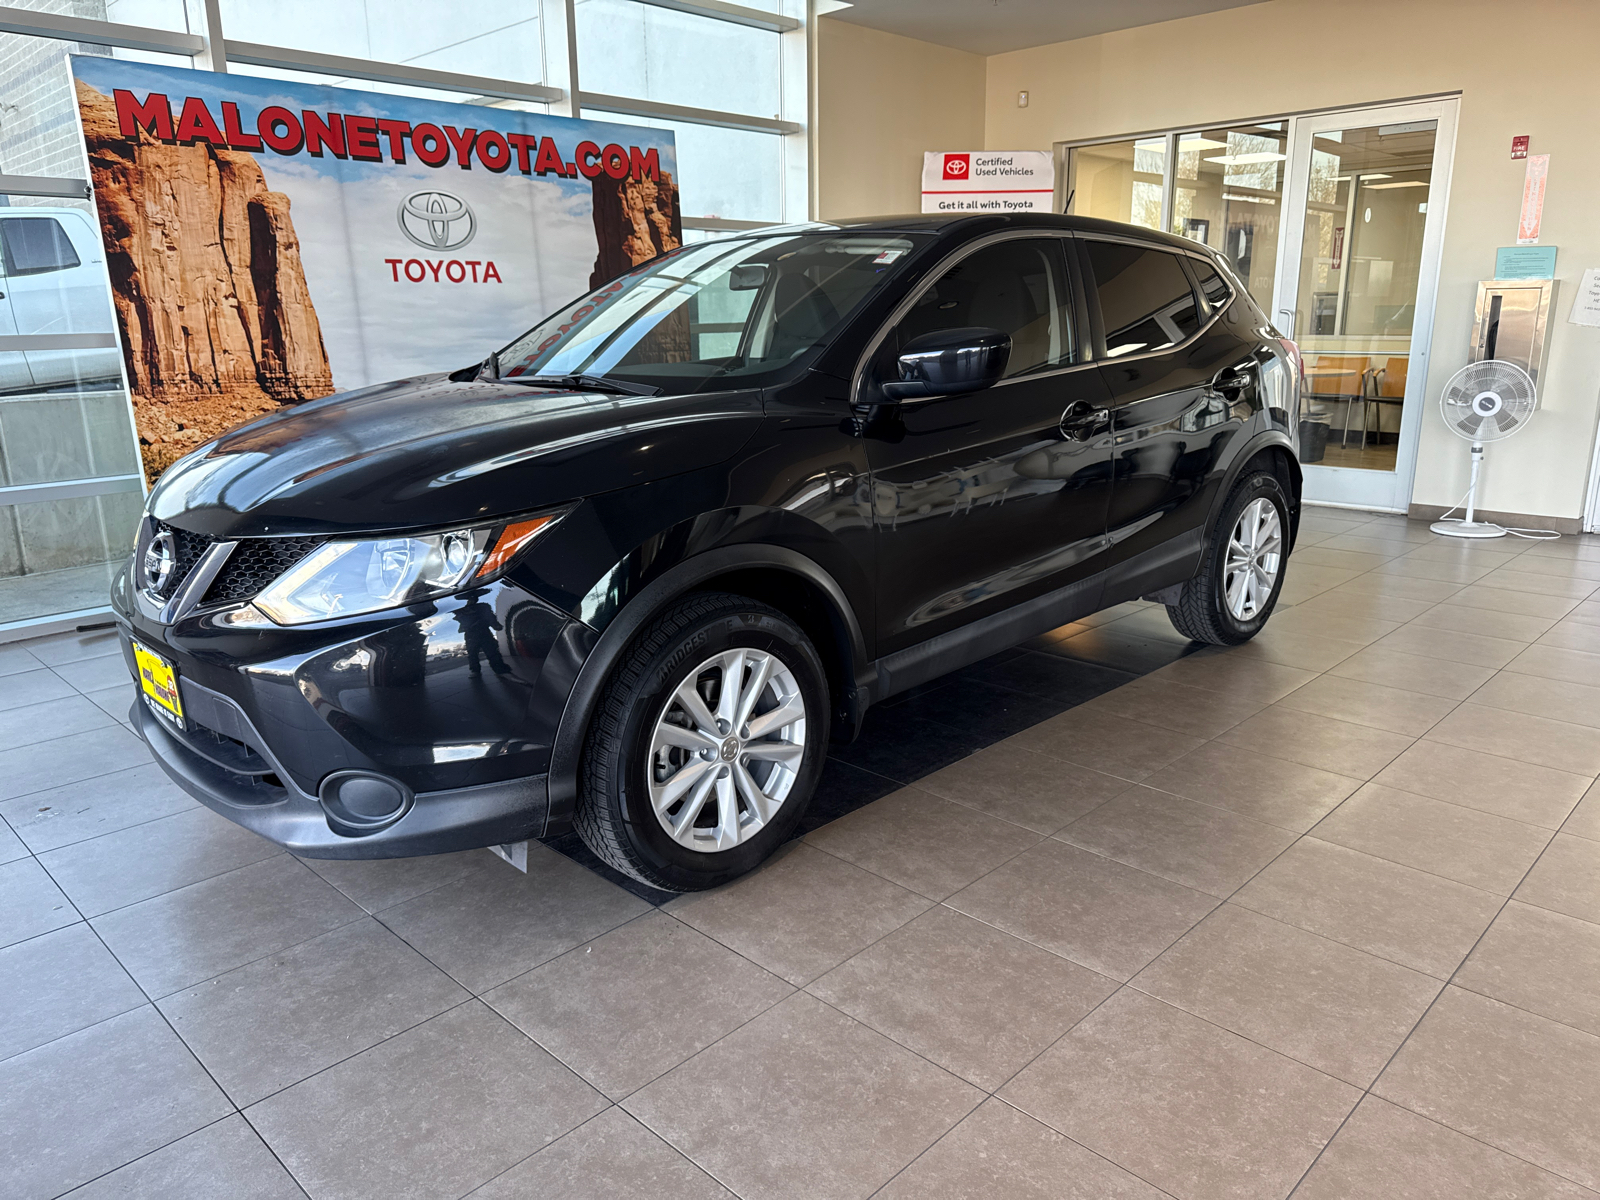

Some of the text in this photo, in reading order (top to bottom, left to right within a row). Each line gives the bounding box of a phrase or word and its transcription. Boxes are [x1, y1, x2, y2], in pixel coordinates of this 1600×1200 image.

[113, 88, 660, 184] MALONETOYOTA.COM
[975, 157, 1013, 166] Certified
[975, 167, 1034, 176] Used Vehicles
[938, 200, 1033, 211] Get it all with Toyota
[384, 257, 502, 284] TOYOTA
